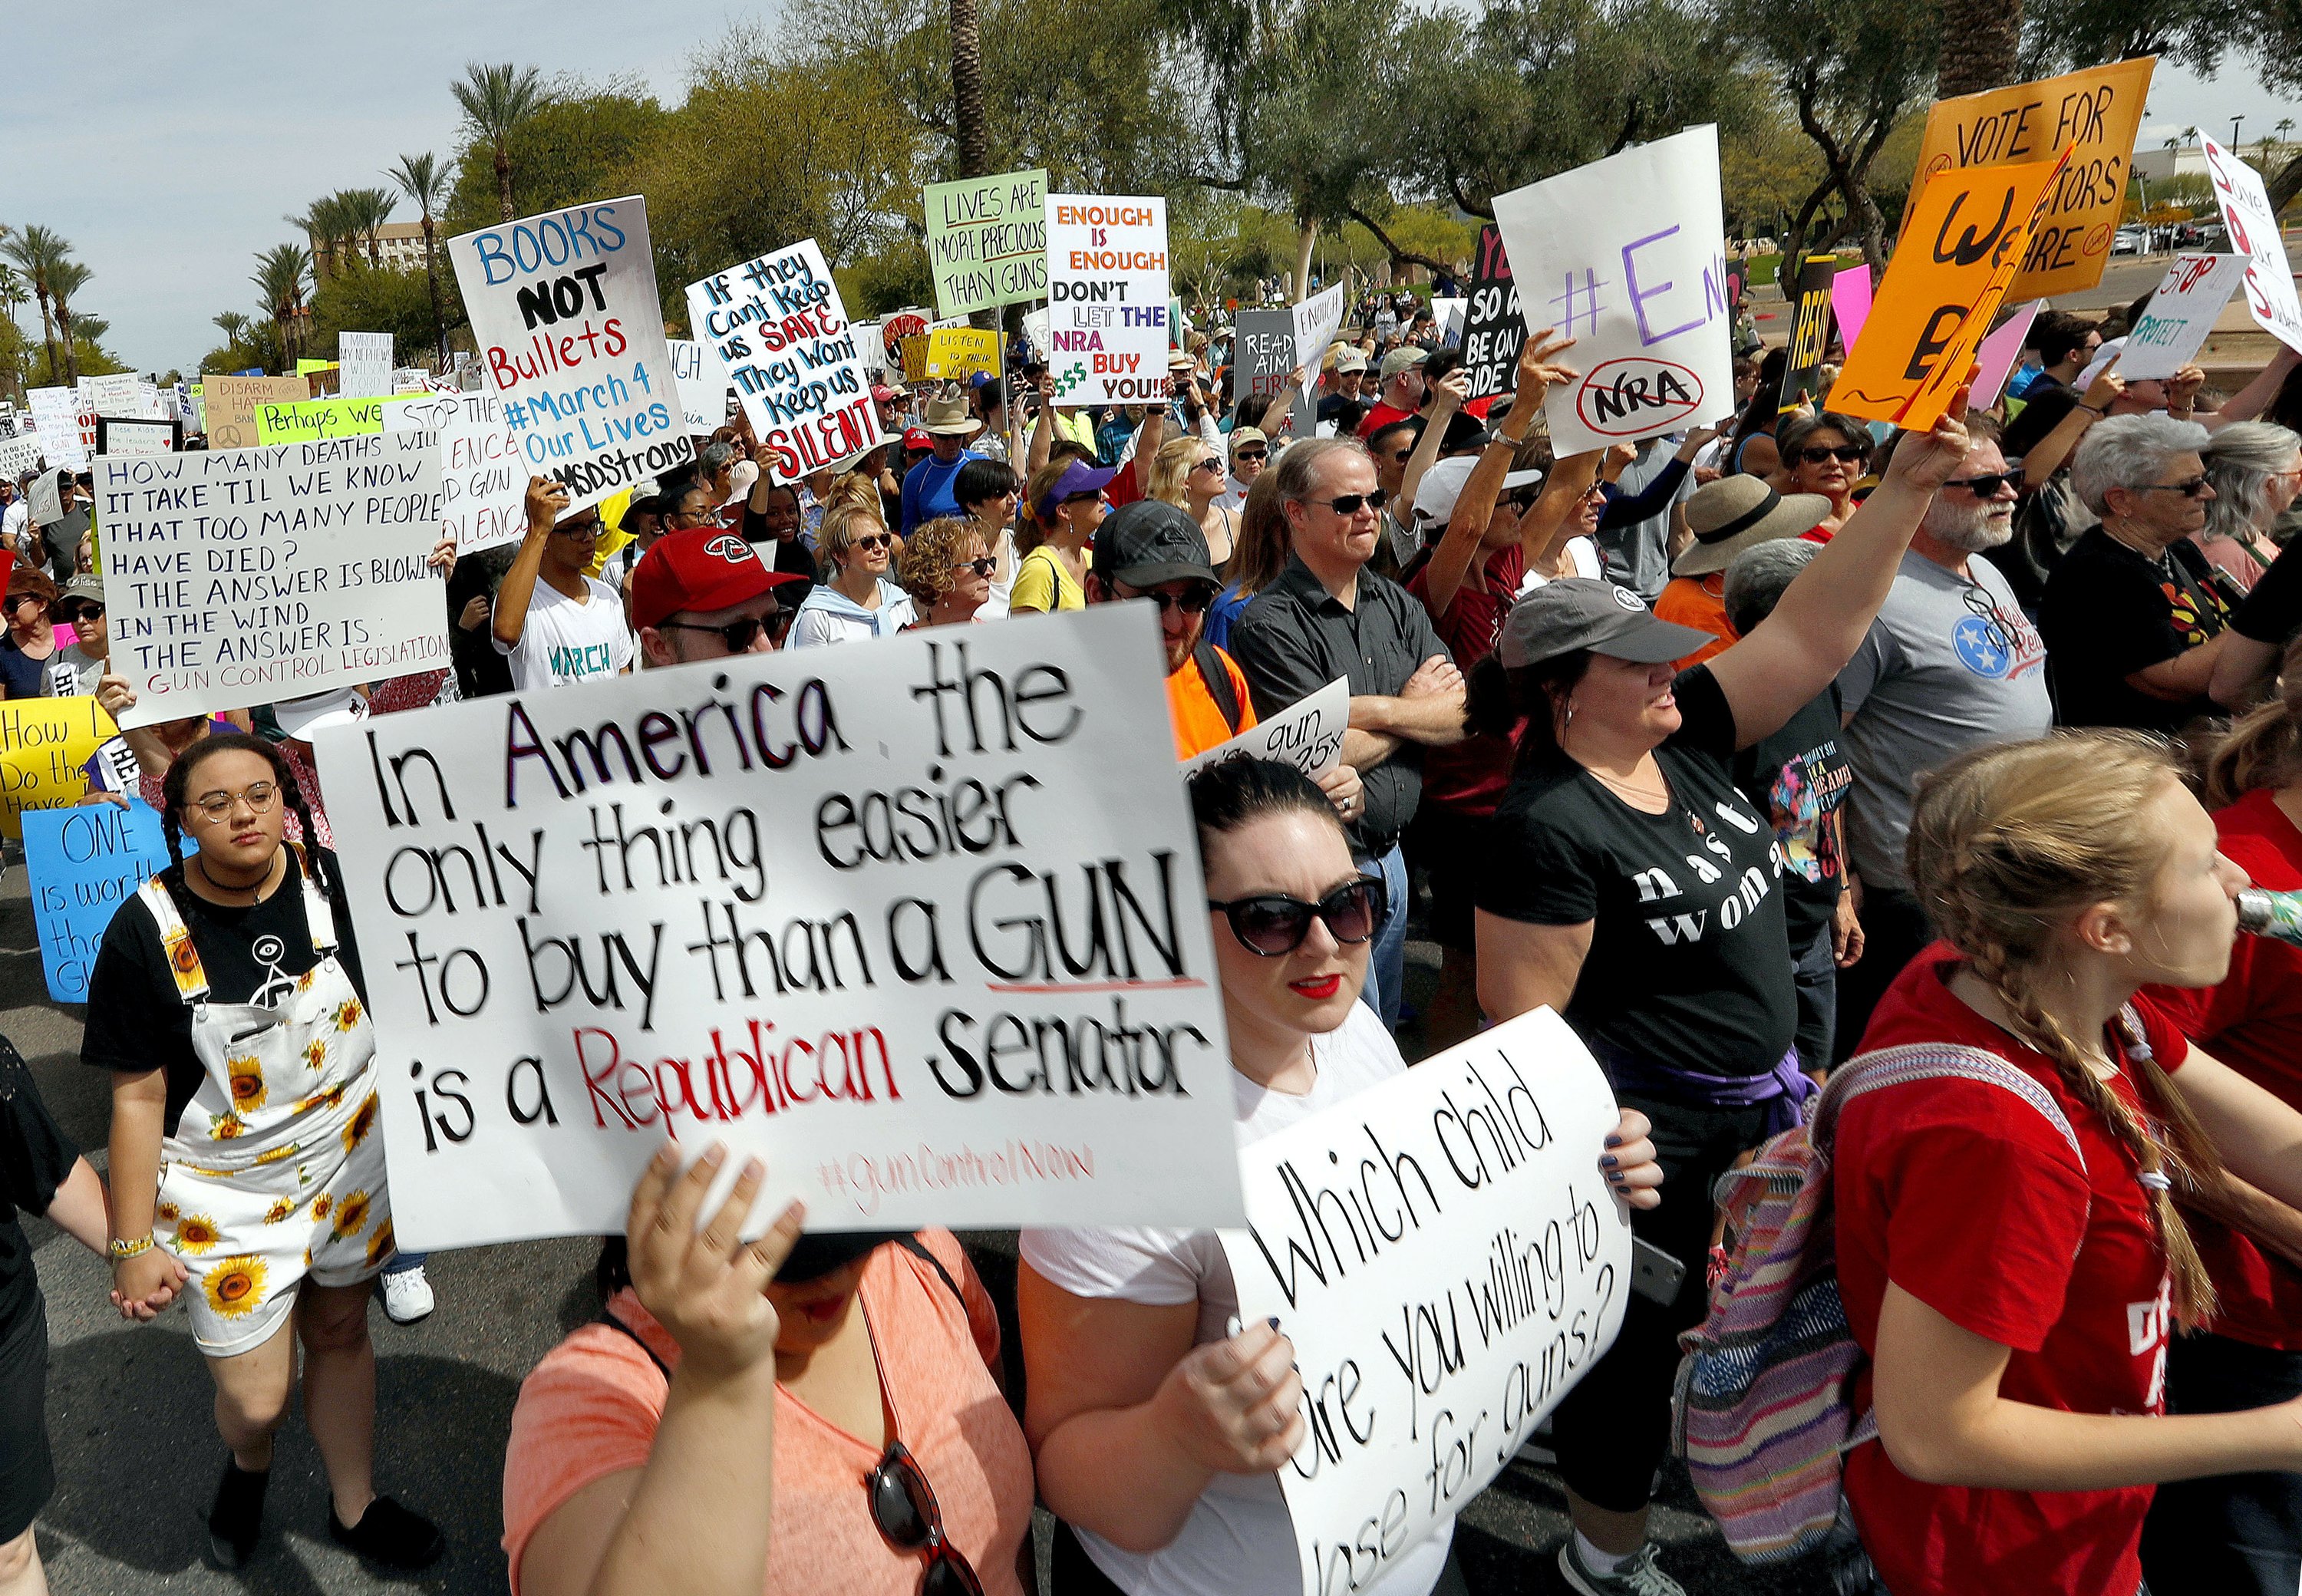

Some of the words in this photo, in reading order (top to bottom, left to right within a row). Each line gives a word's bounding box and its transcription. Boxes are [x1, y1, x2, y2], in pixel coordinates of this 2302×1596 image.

[1958, 102, 2042, 168] VOTE
[2053, 84, 2113, 151] FOR
[945, 187, 1003, 225] LIVES
[1009, 180, 1041, 213] ARE
[2050, 156, 2121, 216] TORS
[1057, 206, 1153, 227] ENOUGH
[1092, 228, 1106, 246] IS
[472, 206, 625, 285] BOOKS
[935, 228, 978, 265] MORE
[982, 216, 1047, 259] PRECIOUS
[1070, 251, 1165, 271] ENOUGH
[516, 262, 607, 331] NOT
[702, 274, 733, 307] If
[741, 252, 813, 290] they
[945, 267, 995, 305] THAN
[1001, 259, 1047, 294] GUNS
[1053, 282, 1129, 302] DON'T
[2160, 256, 2217, 295] STOP
[1073, 305, 1114, 328] LET
[1121, 305, 1166, 327] THE
[1300, 292, 1339, 337] ENOUGH
[1470, 286, 1502, 325] SO
[340, 348, 353, 361] MY
[355, 348, 392, 361] NEPHEWS
[487, 318, 627, 390] Bullets
[718, 335, 751, 362] us
[940, 335, 984, 348] LISTEN
[966, 353, 991, 363] THEIR
[1053, 331, 1104, 351] NRA
[1093, 353, 1140, 374] BUY
[1245, 333, 1296, 355] READ
[1466, 331, 1492, 365] BE
[1494, 325, 1521, 361] ON
[220, 383, 272, 395] DISARM
[350, 361, 386, 375] WILSON
[731, 358, 800, 396] They
[829, 365, 859, 396] us
[404, 398, 459, 429] STOP
[463, 397, 497, 423] THE
[503, 374, 629, 430] #March
[632, 361, 651, 395] 4
[1594, 371, 1690, 424] NRA
[265, 405, 337, 438] Perhaps
[526, 430, 574, 464] Our
[579, 403, 671, 451] Lives
[764, 396, 876, 479] SILENT
[108, 458, 183, 486] HOW
[204, 448, 288, 476] MANY
[303, 437, 381, 466] DEATHS
[397, 430, 439, 451] WILL
[543, 435, 692, 497] MSDStrong
[106, 492, 134, 514] IT
[145, 486, 208, 510] TAKE
[289, 473, 331, 499] WE
[346, 460, 422, 491] KNOW
[470, 466, 510, 499] GUN
[106, 521, 183, 543] THAT
[199, 516, 249, 542] TOO
[261, 501, 356, 534] MANY
[366, 493, 441, 525] PEOPLE
[113, 552, 191, 575] HAVE
[208, 540, 298, 573] DIED?
[130, 583, 191, 609] THE
[206, 569, 328, 605] ANSWER
[339, 563, 363, 589] IS
[114, 618, 153, 642] IN
[168, 612, 219, 636] THE
[230, 602, 309, 629] WIND
[134, 644, 203, 671] THE
[217, 624, 331, 663] ANSWER
[147, 670, 209, 695] GUN
[220, 658, 335, 688] CONTROL
[341, 633, 449, 671] LEGISLATION
[548, 642, 610, 676] MARCH
[2, 709, 68, 752] How
[366, 731, 457, 829] In
[504, 673, 853, 810] America
[909, 638, 1086, 758] the
[1266, 708, 1321, 761] gun
[0, 762, 38, 793] Do
[62, 810, 140, 864] ONE
[384, 821, 546, 918] only
[581, 796, 769, 904] thing
[814, 764, 1044, 873] easier
[1631, 786, 1759, 902] nast
[38, 877, 68, 913] is
[395, 930, 488, 1027] to
[516, 915, 665, 1034] buy
[690, 899, 874, 1001] than
[889, 895, 954, 988] a
[968, 849, 1196, 984] GUN
[409, 1061, 476, 1153] is
[506, 1055, 561, 1130] a
[572, 1016, 904, 1143] Republican
[1247, 1121, 1443, 1311] Which
[1434, 1048, 1554, 1191] child
[1381, 1288, 1466, 1443] you
[1464, 1218, 1567, 1351] willing
[1568, 1184, 1600, 1274] to
[1424, 1407, 1489, 1518] for
[1497, 1264, 1616, 1464] guns?
